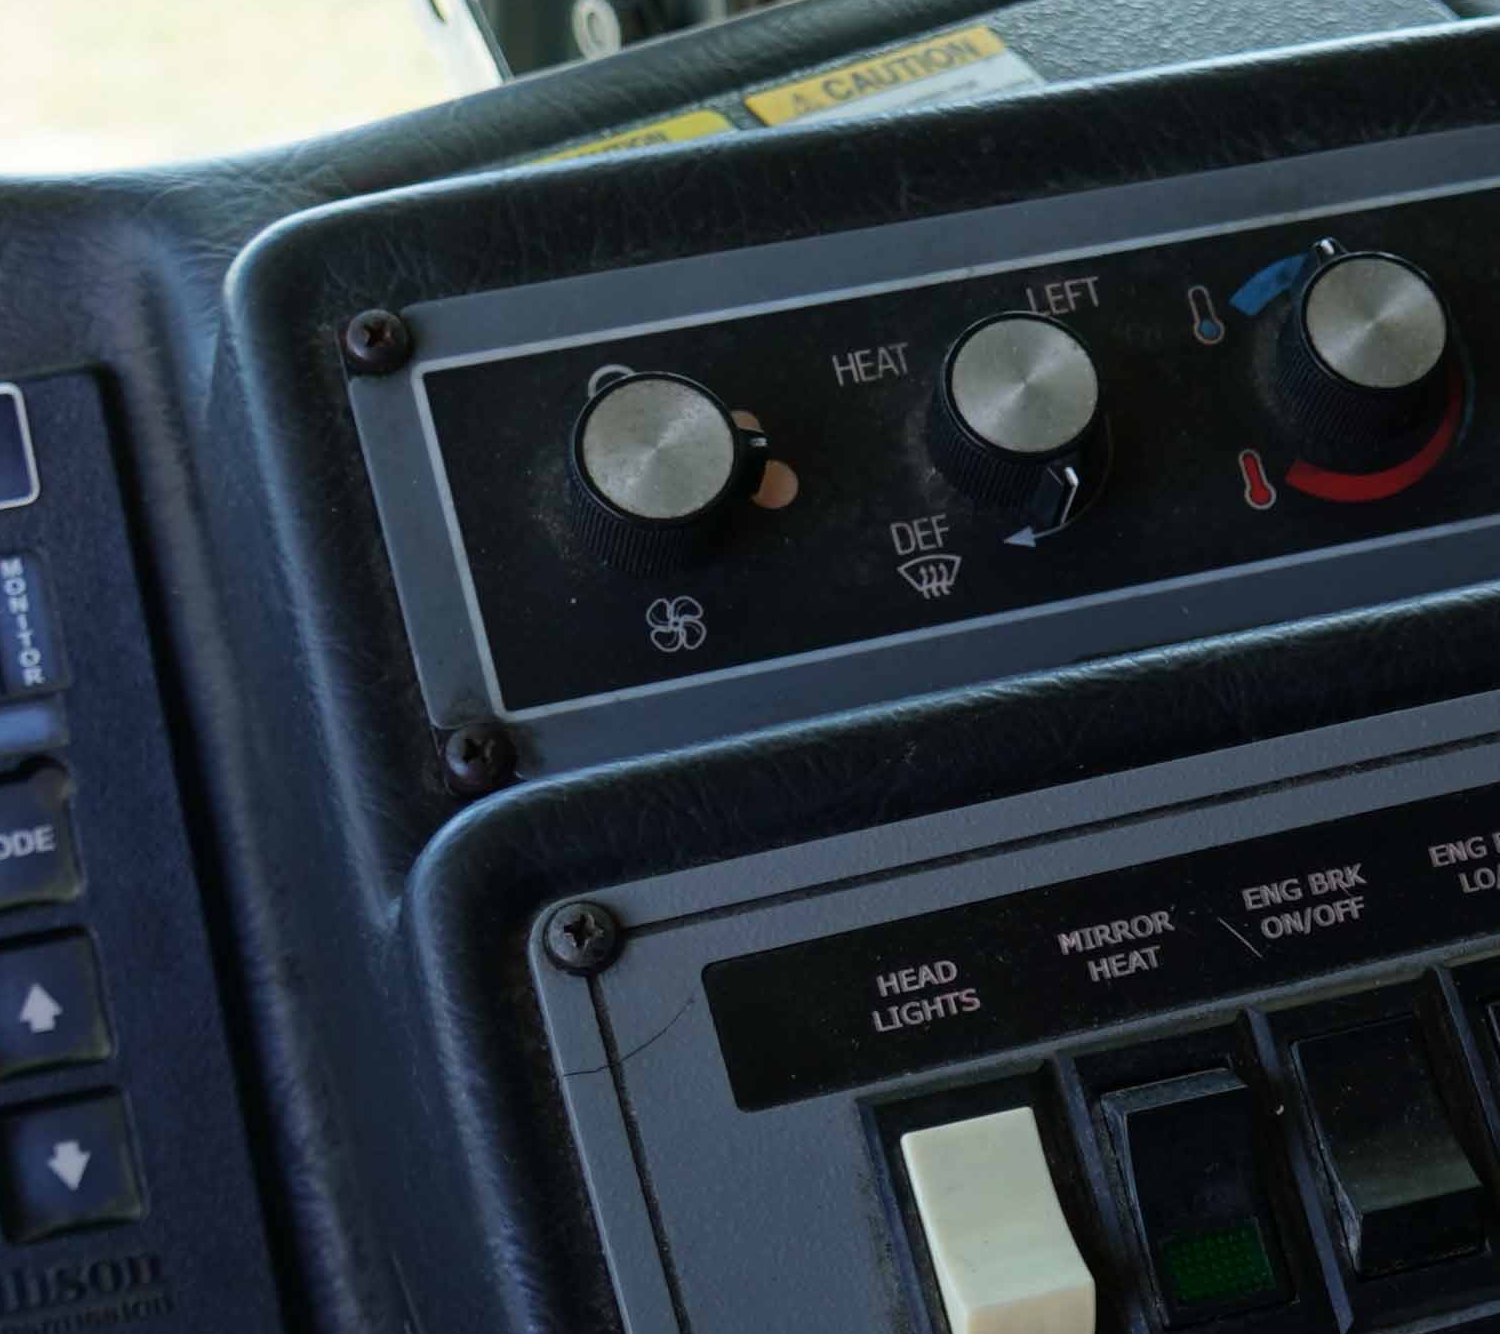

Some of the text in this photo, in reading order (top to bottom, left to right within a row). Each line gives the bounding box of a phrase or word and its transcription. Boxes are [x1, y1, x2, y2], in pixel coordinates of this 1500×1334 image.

[822, 42, 981, 101] CAUTION
[1027, 276, 1100, 315] LEFT
[832, 342, 909, 387] HEAT
[890, 514, 950, 556] DEF
[0, 558, 46, 687] MONITOR
[1428, 833, 1488, 869] ENG
[1242, 863, 1367, 911] ENG BRK
[1057, 909, 1175, 957] MIRROR
[1260, 896, 1366, 941] ON/OFF
[876, 960, 959, 999] HEAD
[1086, 945, 1163, 984] HEAT
[871, 987, 981, 1034] LIGHTS
